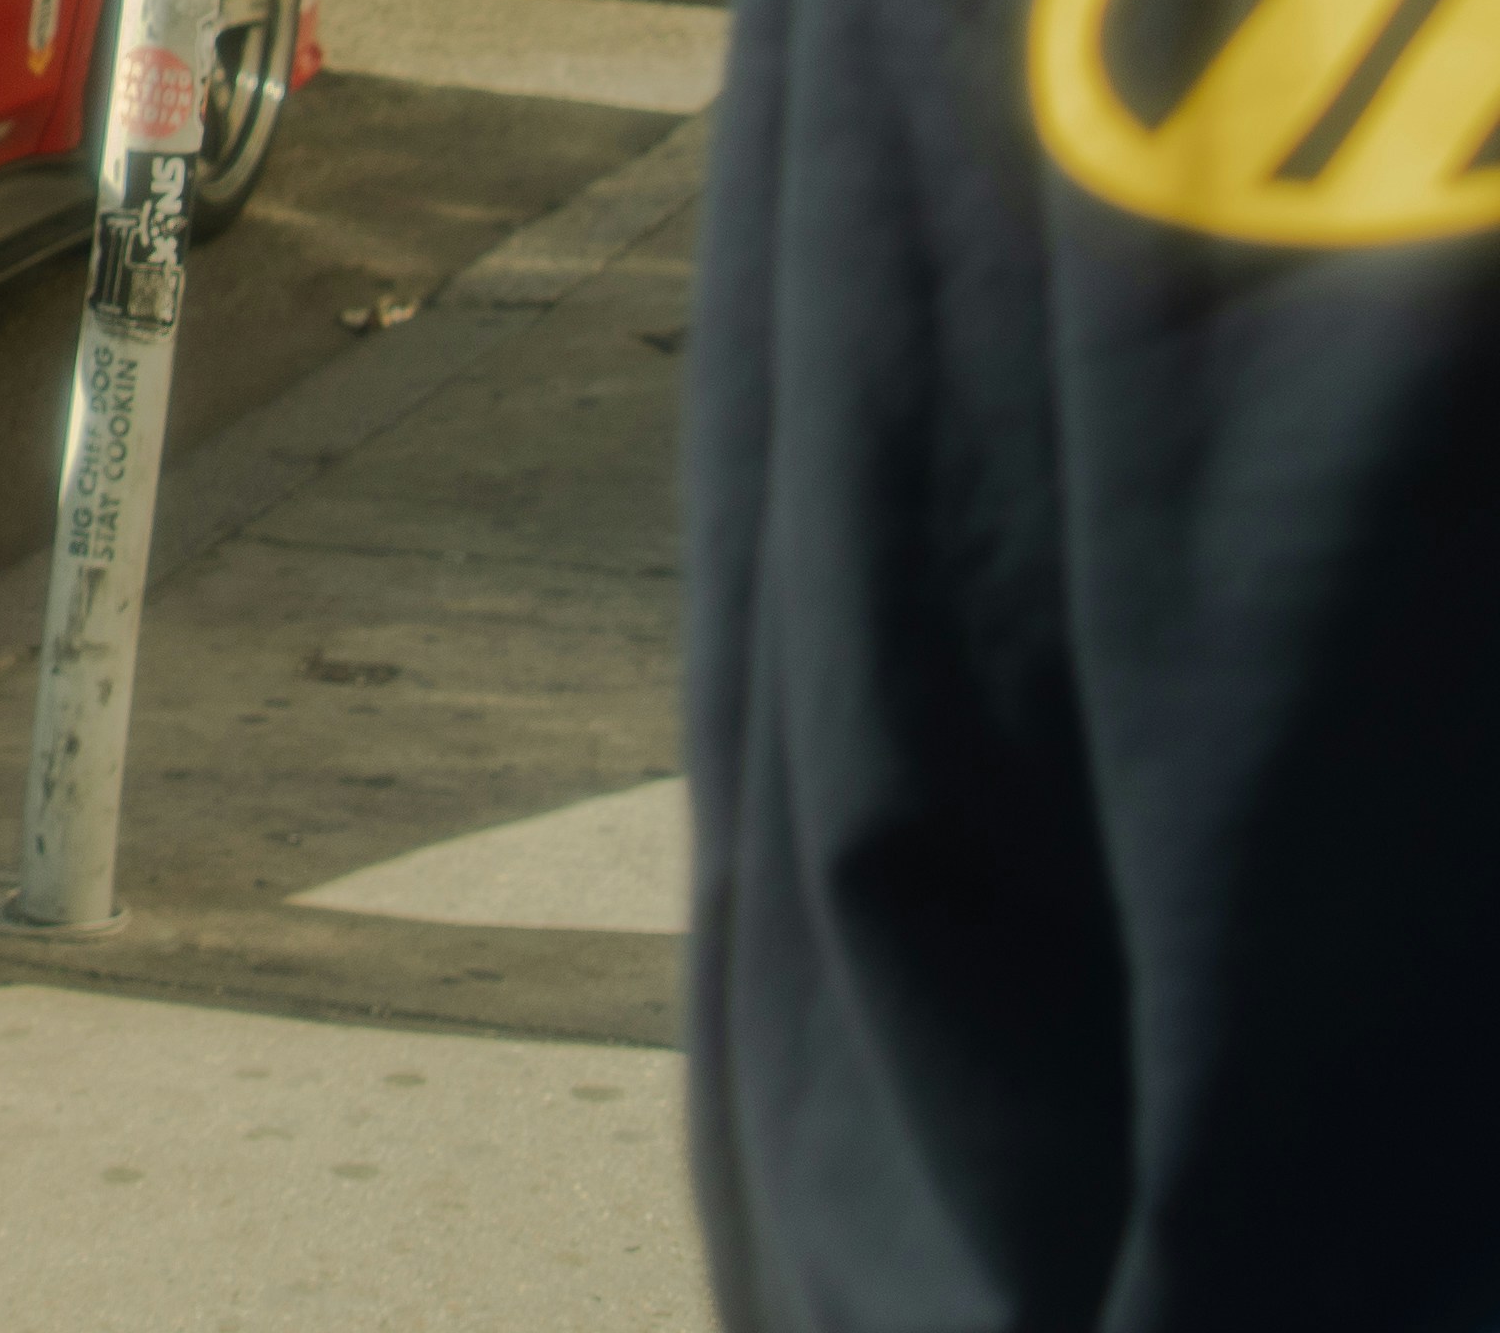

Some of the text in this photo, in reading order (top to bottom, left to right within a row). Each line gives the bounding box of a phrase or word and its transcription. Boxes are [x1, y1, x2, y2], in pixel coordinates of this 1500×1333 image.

[68, 505, 93, 558] BIG
[90, 344, 114, 415] DOG
[91, 358, 139, 563] STAY COOKIN
